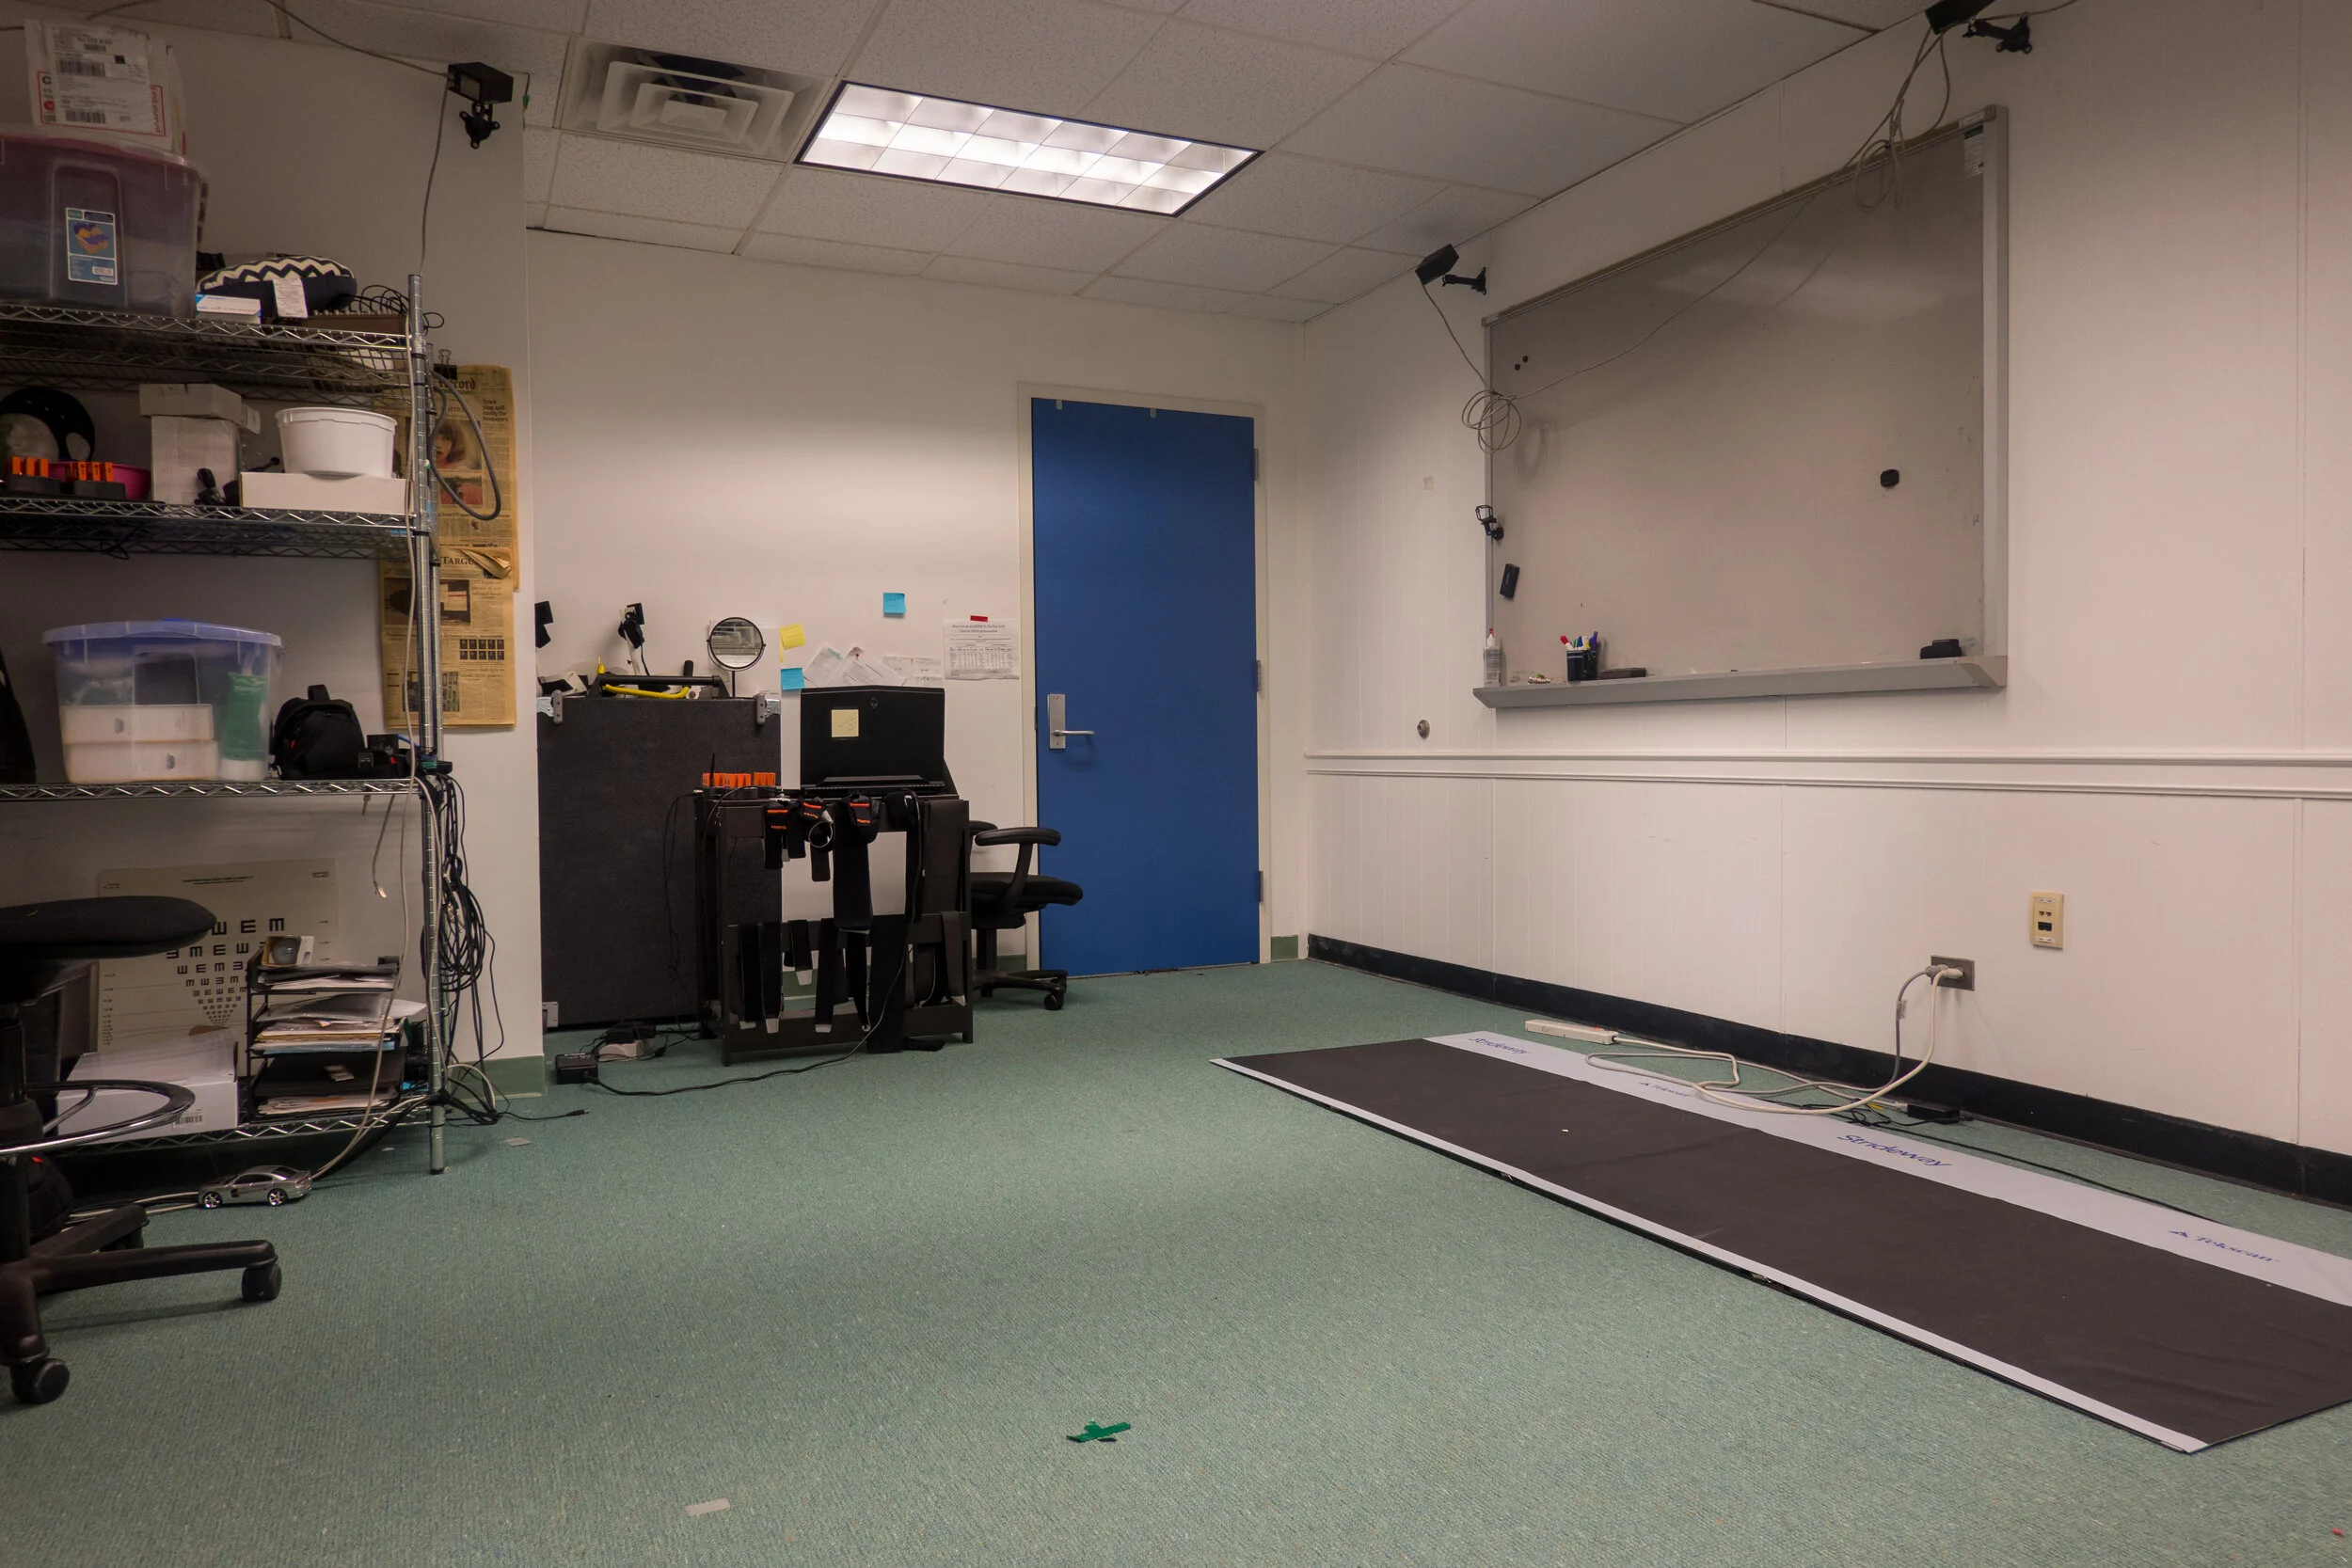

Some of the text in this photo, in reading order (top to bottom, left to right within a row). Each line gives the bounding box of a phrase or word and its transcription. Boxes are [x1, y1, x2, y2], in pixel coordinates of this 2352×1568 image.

[441, 556, 478, 565] TARGU
[1836, 1134, 1953, 1166] Strideway
[2195, 1235, 2274, 1262] Tekscan
